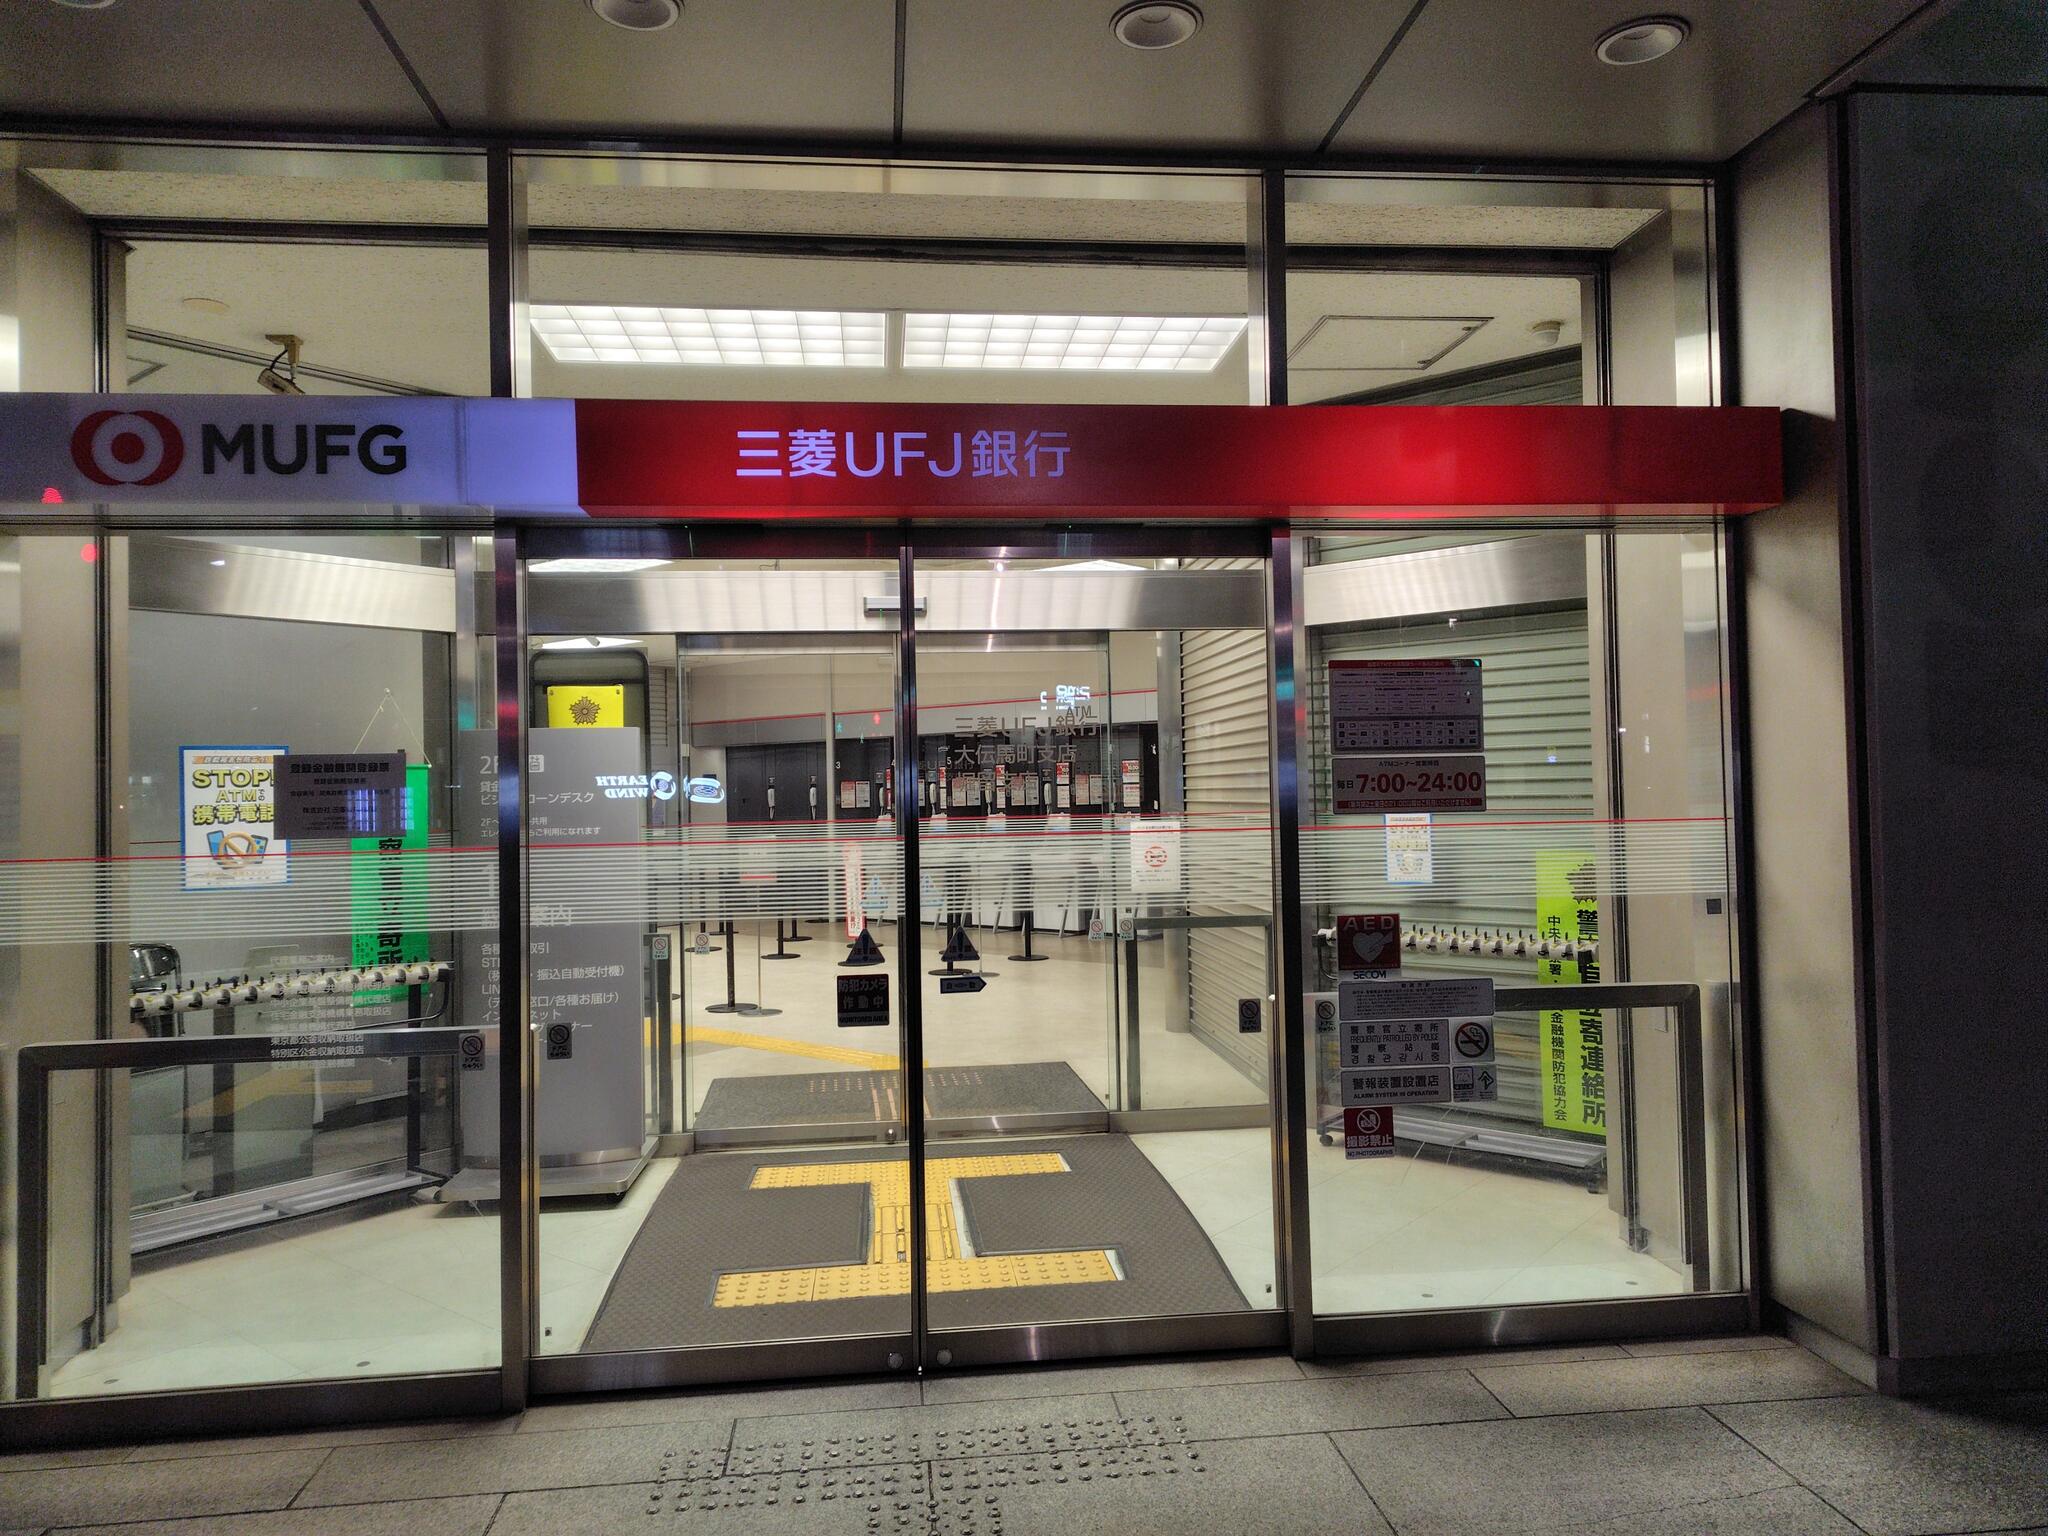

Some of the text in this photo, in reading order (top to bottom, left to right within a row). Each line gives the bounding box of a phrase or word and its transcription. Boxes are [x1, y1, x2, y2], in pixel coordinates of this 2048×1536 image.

[201, 423, 408, 476] MUFG
[736, 428, 1071, 478] 三菱UFJ銀行
[1066, 705, 1093, 717] ATM
[954, 715, 1100, 738] 三菱UFJ銀行
[946, 757, 952, 765] 5
[954, 744, 1078, 764] 大伝馬町支店
[836, 761, 841, 769] 3
[1336, 779, 1355, 790] 毎日
[216, 788, 258, 803] ATM
[1343, 916, 1394, 931] AED
[1353, 970, 1387, 980] SECOM
[839, 979, 887, 993] 防犯カメラ
[1420, 1032, 1439, 1041] POLICE
[1352, 1075, 1440, 1090] 警報装置設置店
[1353, 1092, 1376, 1100] ALARM
[1346, 1134, 1393, 1148] 撮影禁止
